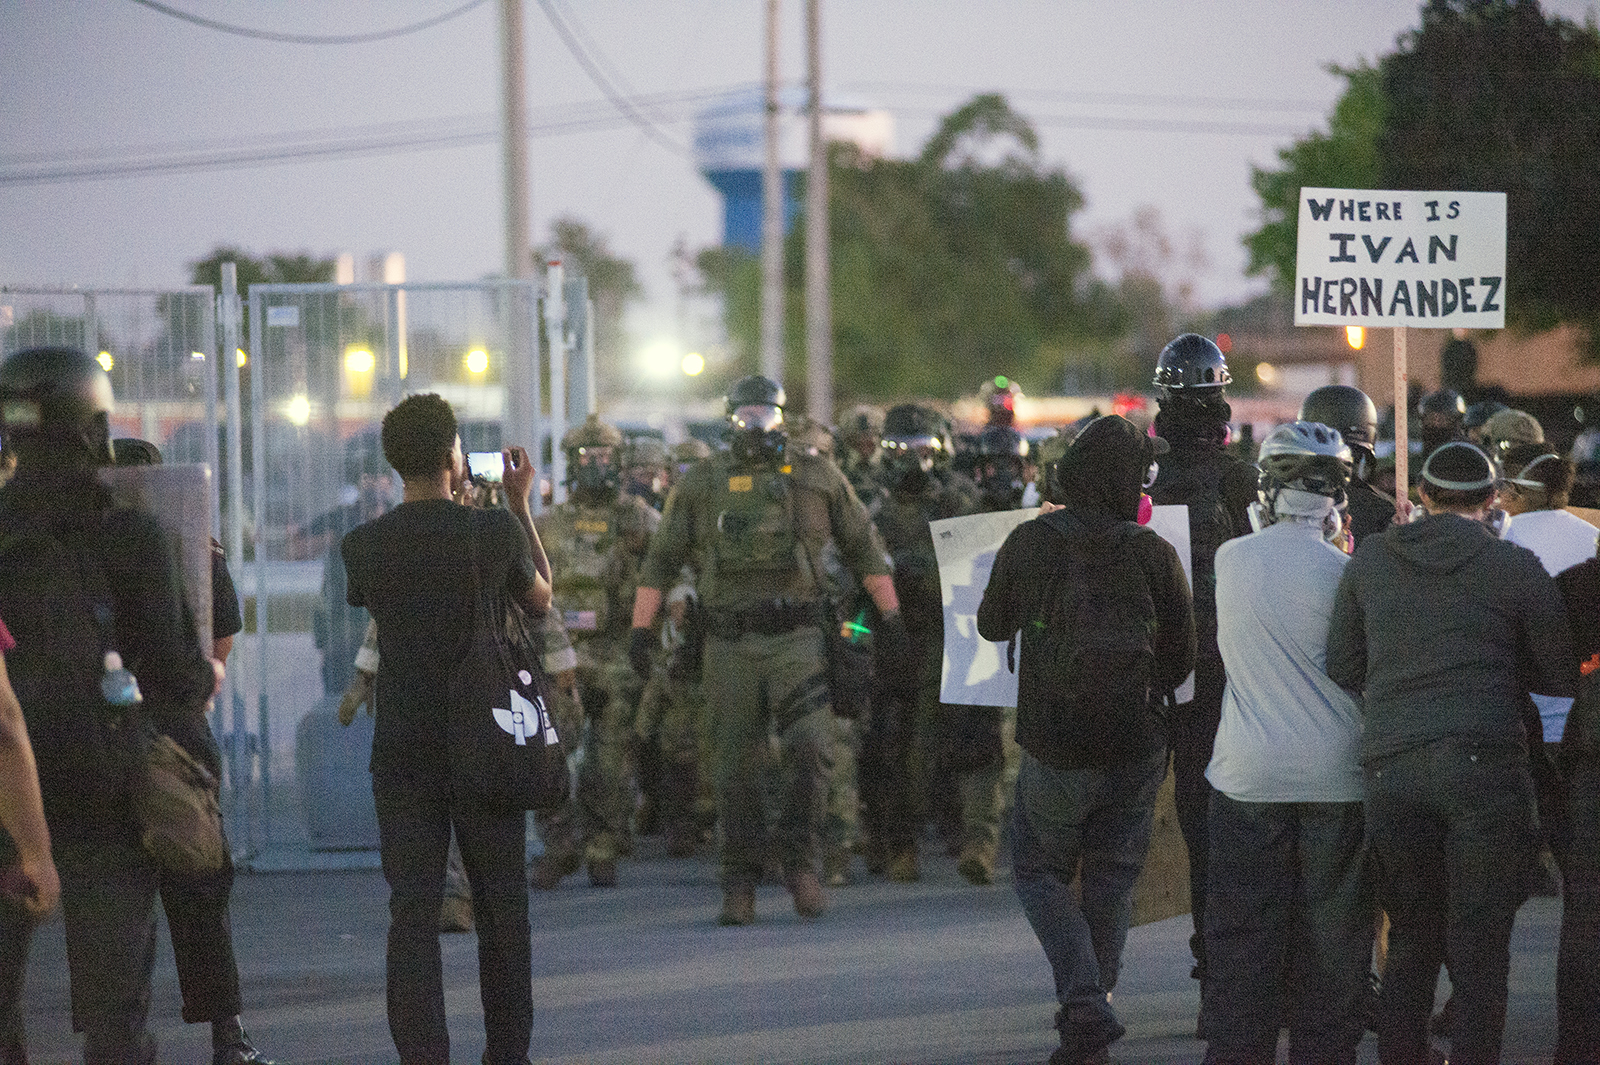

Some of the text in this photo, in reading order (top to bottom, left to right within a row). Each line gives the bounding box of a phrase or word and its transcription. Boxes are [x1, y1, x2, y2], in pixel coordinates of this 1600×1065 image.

[1306, 198, 1461, 222] WHERE IS
[1329, 233, 1459, 264] IVAN
[1302, 276, 1502, 317] HERNANDEZ
